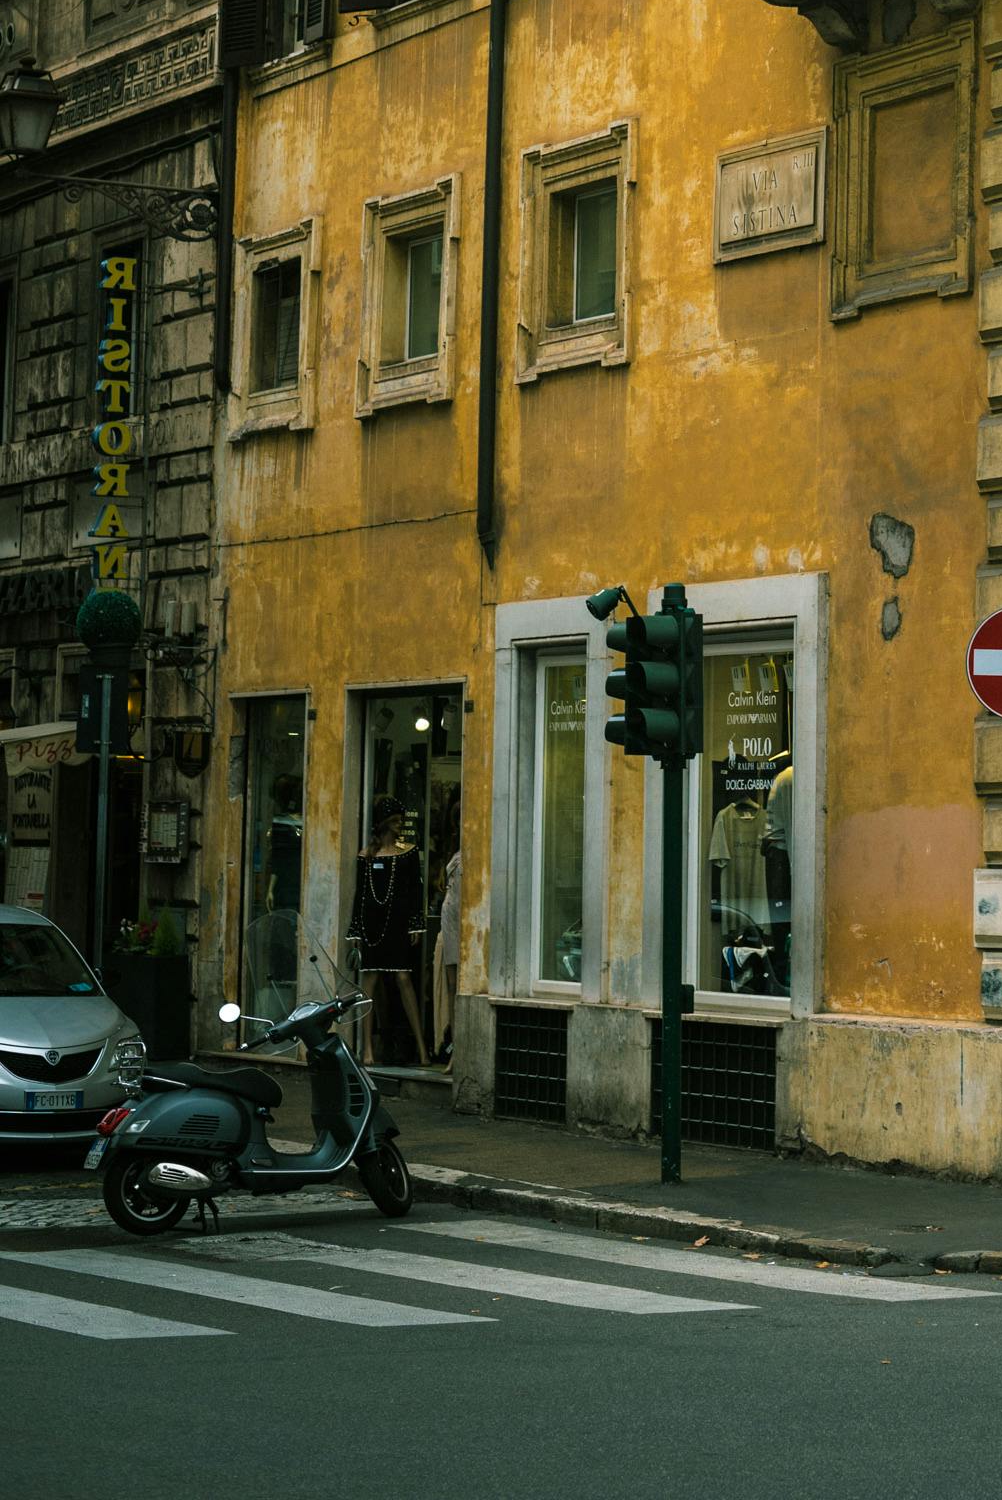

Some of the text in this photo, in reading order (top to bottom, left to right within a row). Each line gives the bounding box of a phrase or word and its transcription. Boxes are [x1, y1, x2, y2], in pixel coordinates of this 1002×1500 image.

[753, 170, 778, 191] VIA
[733, 204, 797, 235] SISTINA
[728, 691, 777, 707] Calvin Klein
[550, 700, 573, 715] Calvin
[742, 737, 772, 757] POLO
[737, 761, 777, 771] RALPH LAUREN
[27, 793, 37, 809] LA
